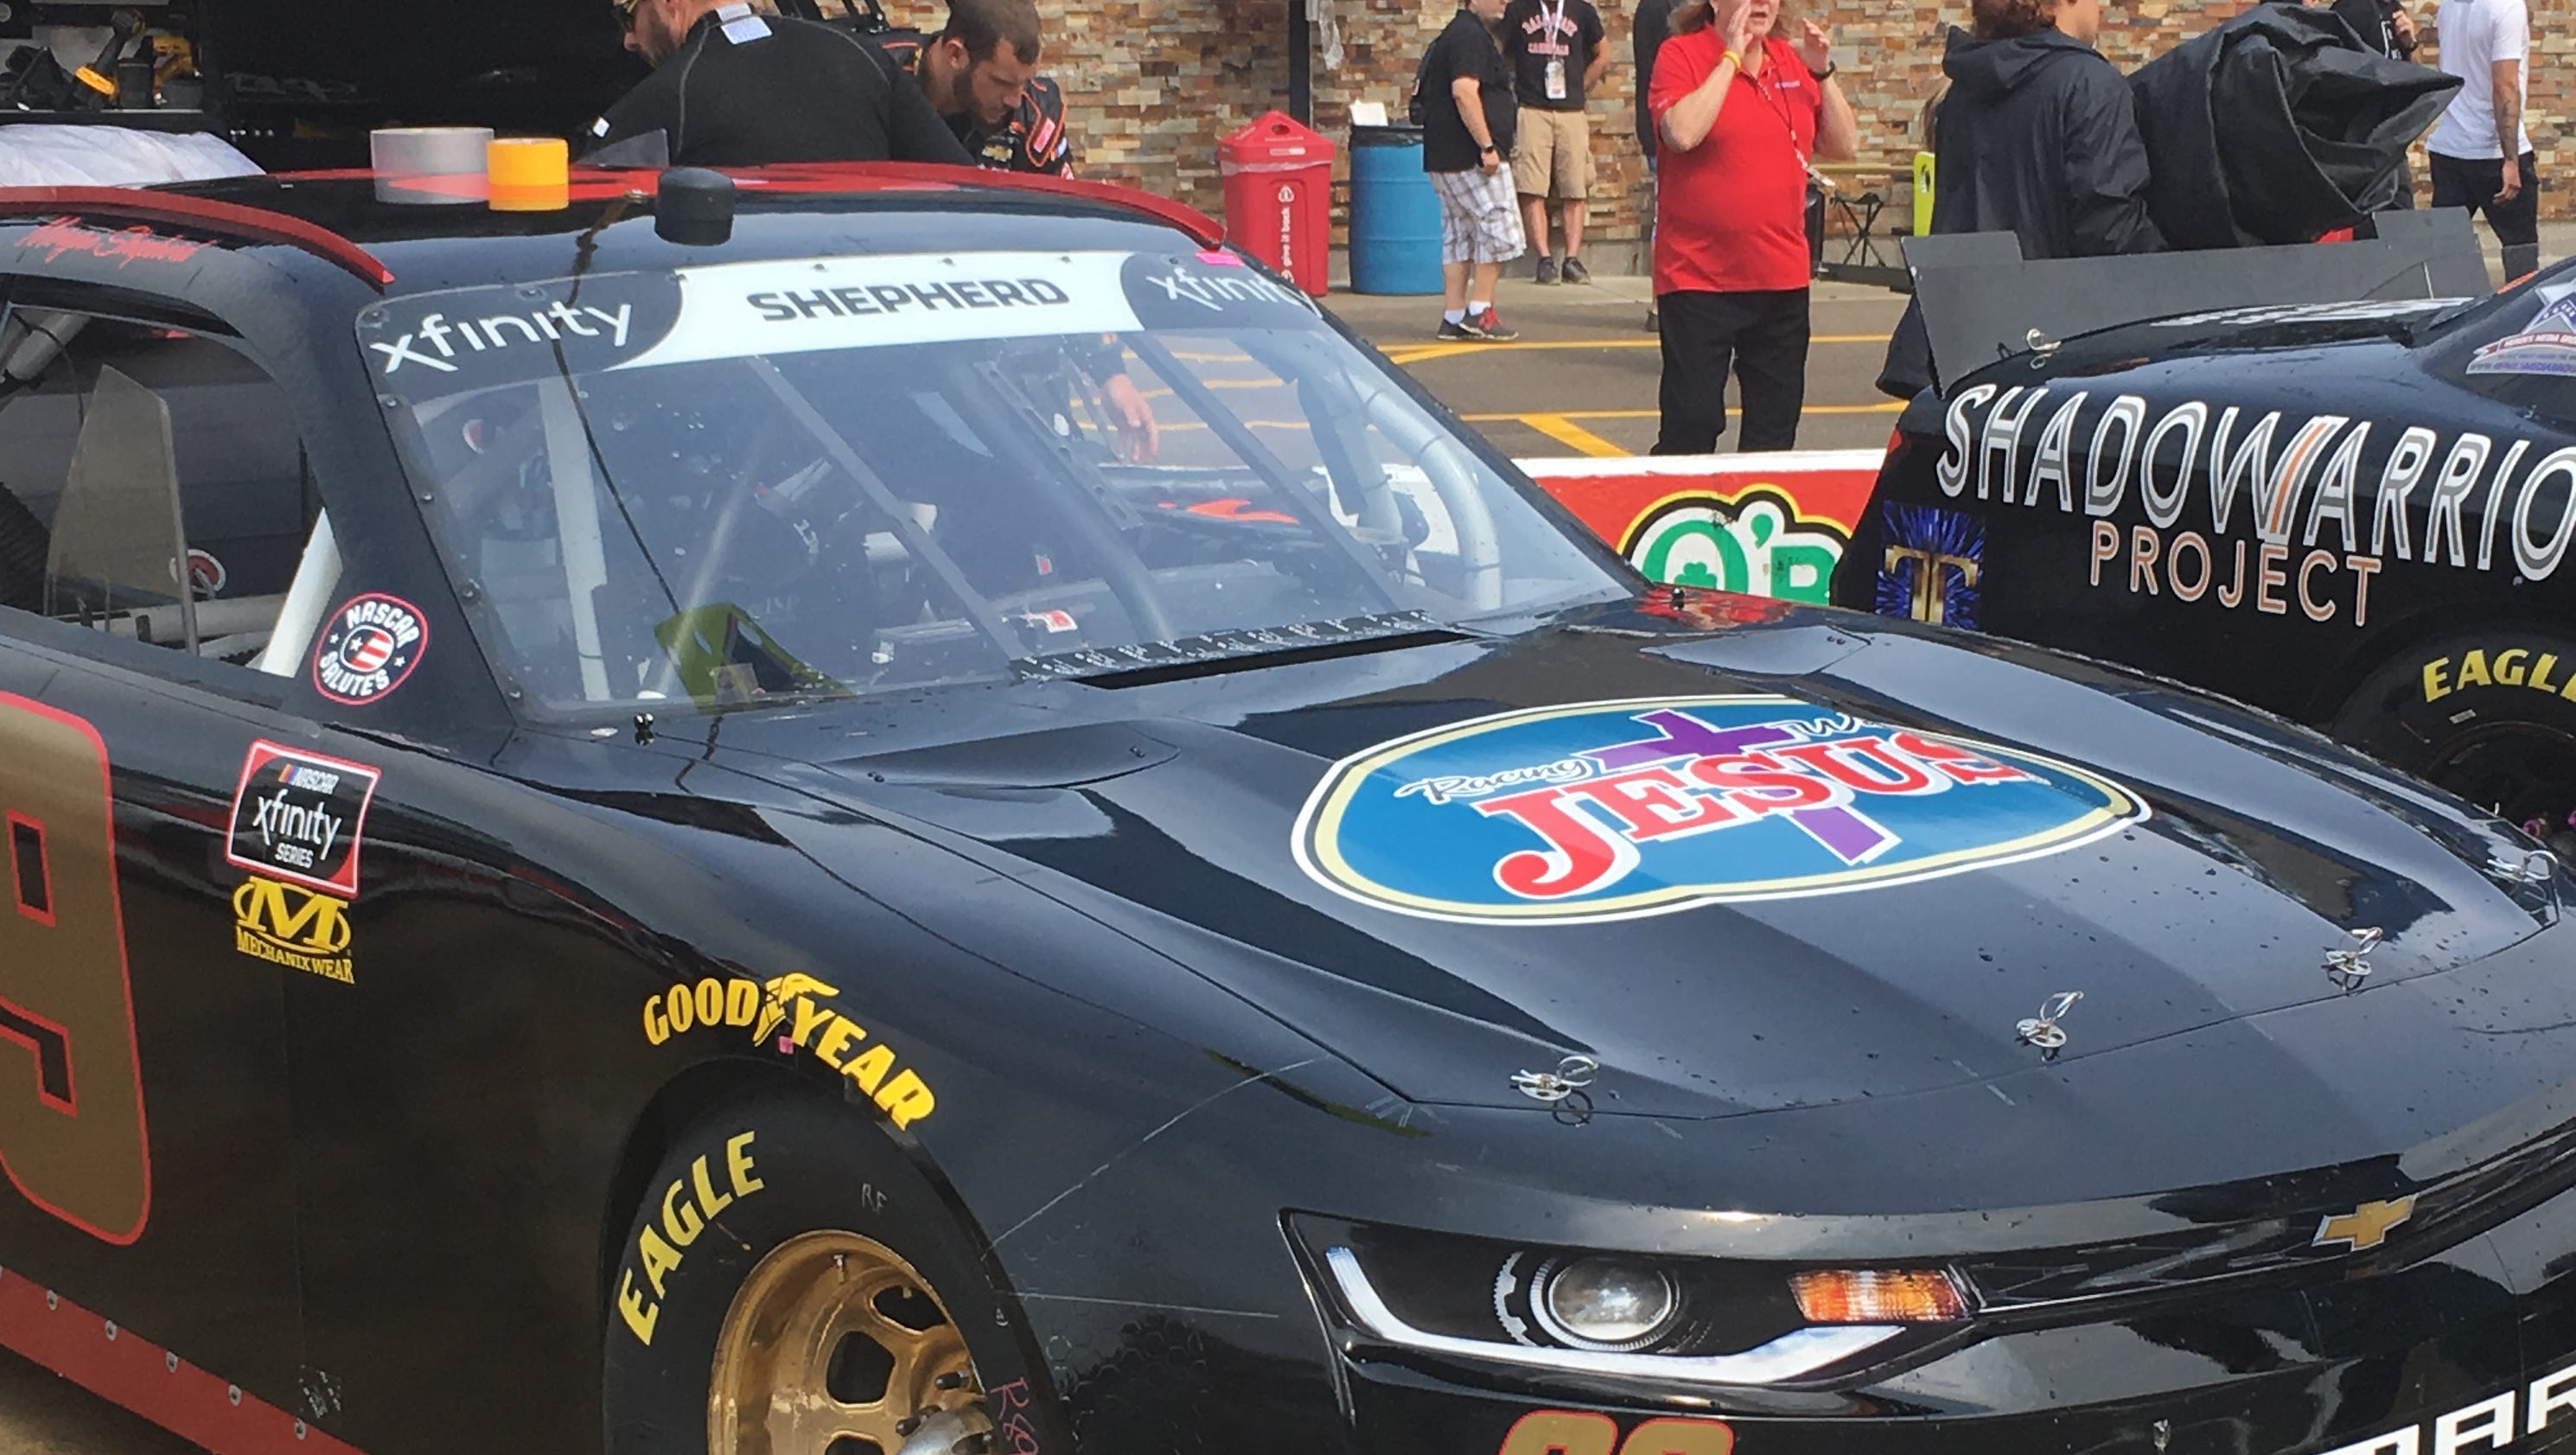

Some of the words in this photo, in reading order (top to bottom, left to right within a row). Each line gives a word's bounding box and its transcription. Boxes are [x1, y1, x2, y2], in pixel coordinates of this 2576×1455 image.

[747, 278, 1070, 321] SHEPHERD
[369, 300, 632, 373] xfinity
[2089, 520, 2382, 627] PROJECT
[347, 601, 419, 648] NASCAR
[319, 651, 390, 696] SALUTES
[2423, 648, 2576, 703] EAGL
[288, 767, 340, 795] NASCAR
[1393, 758, 1593, 805] Racing
[252, 788, 342, 861] xfinity
[1469, 731, 2031, 899] JESUS
[274, 842, 315, 869] SERIES
[236, 925, 311, 972] MECHANIX
[310, 957, 355, 984] WEAR
[618, 1131, 764, 1346] EAGLE
